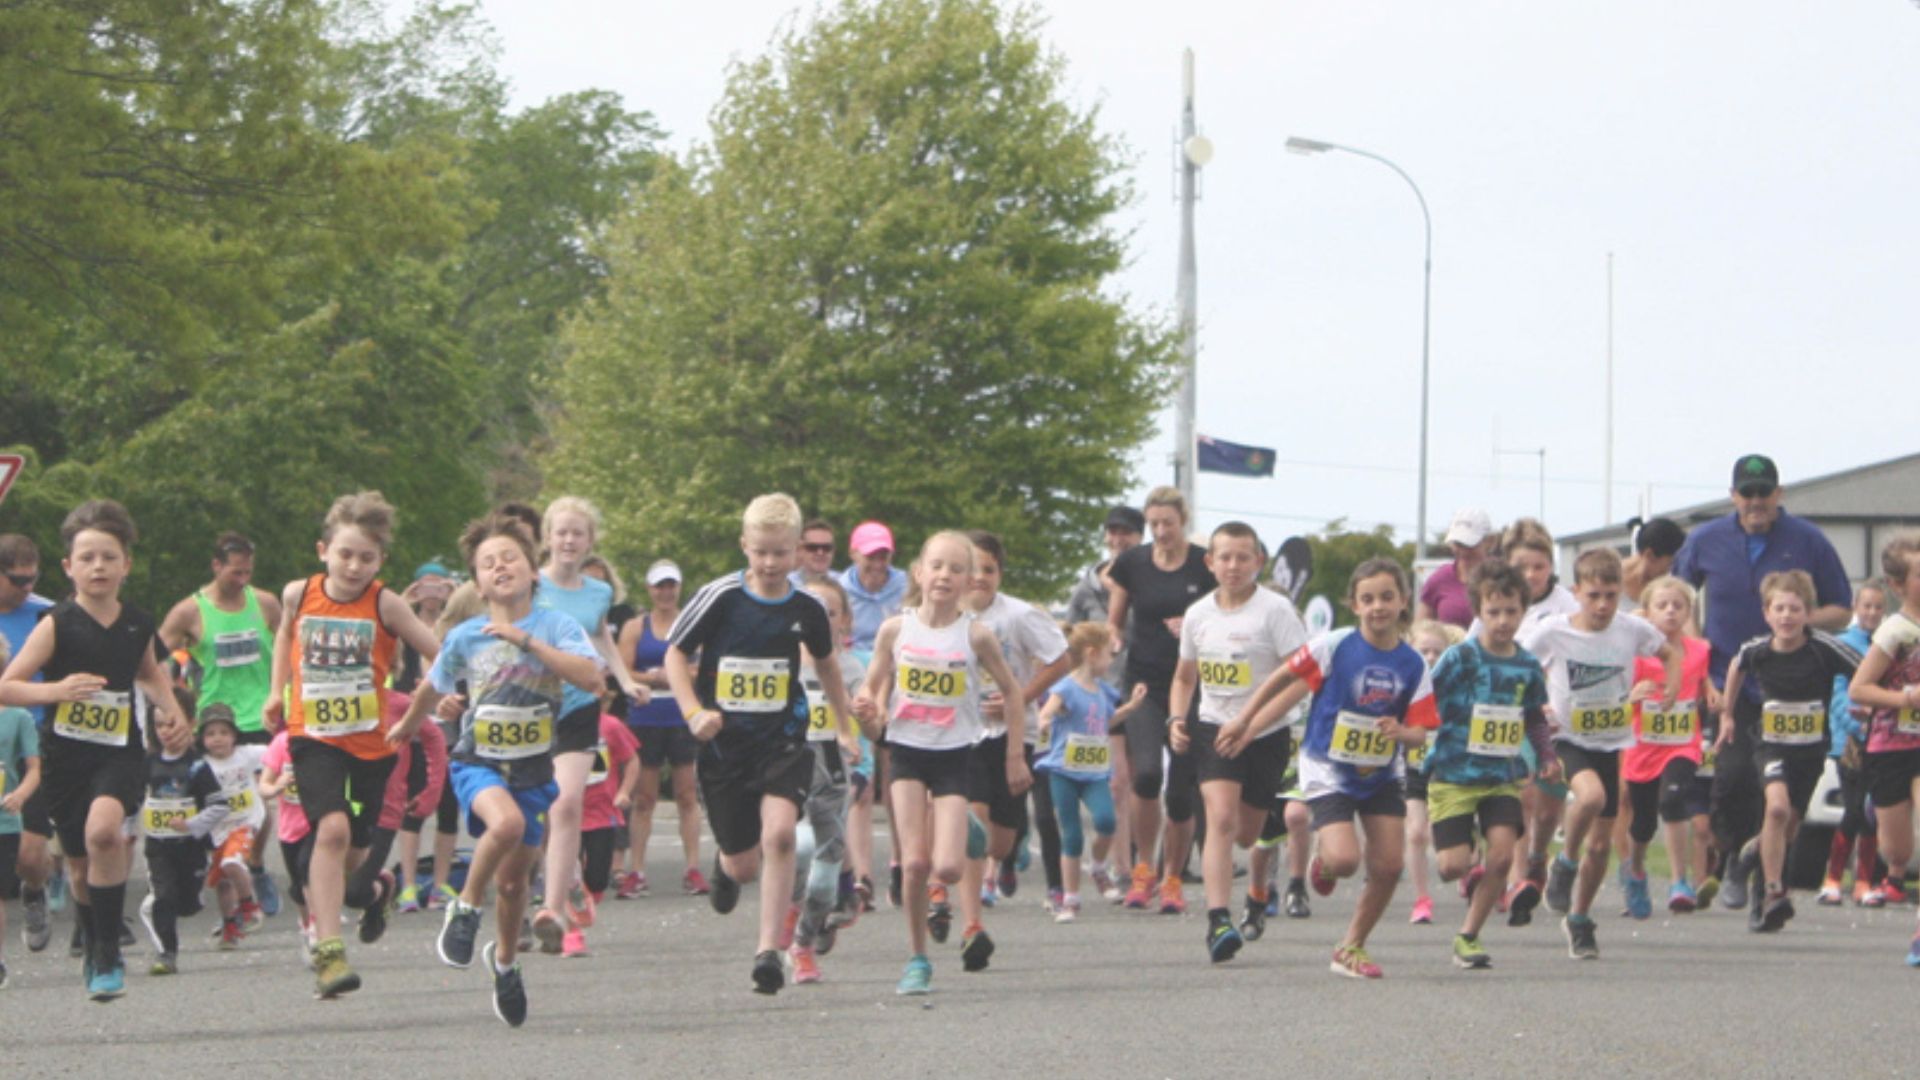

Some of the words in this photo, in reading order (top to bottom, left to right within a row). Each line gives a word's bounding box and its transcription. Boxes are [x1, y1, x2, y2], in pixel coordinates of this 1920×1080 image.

[311, 630, 361, 648] NEW
[730, 674, 777, 699] 816
[907, 669, 955, 695] 820
[68, 704, 119, 730] 830
[316, 699, 363, 724] 831
[1581, 709, 1625, 730] 832
[487, 721, 540, 746] 836
[1482, 722, 1520, 744] 818
[1652, 715, 1690, 733] 814
[1773, 715, 1815, 734] 838
[1344, 731, 1387, 755] 819
[1073, 746, 1107, 764] 850
